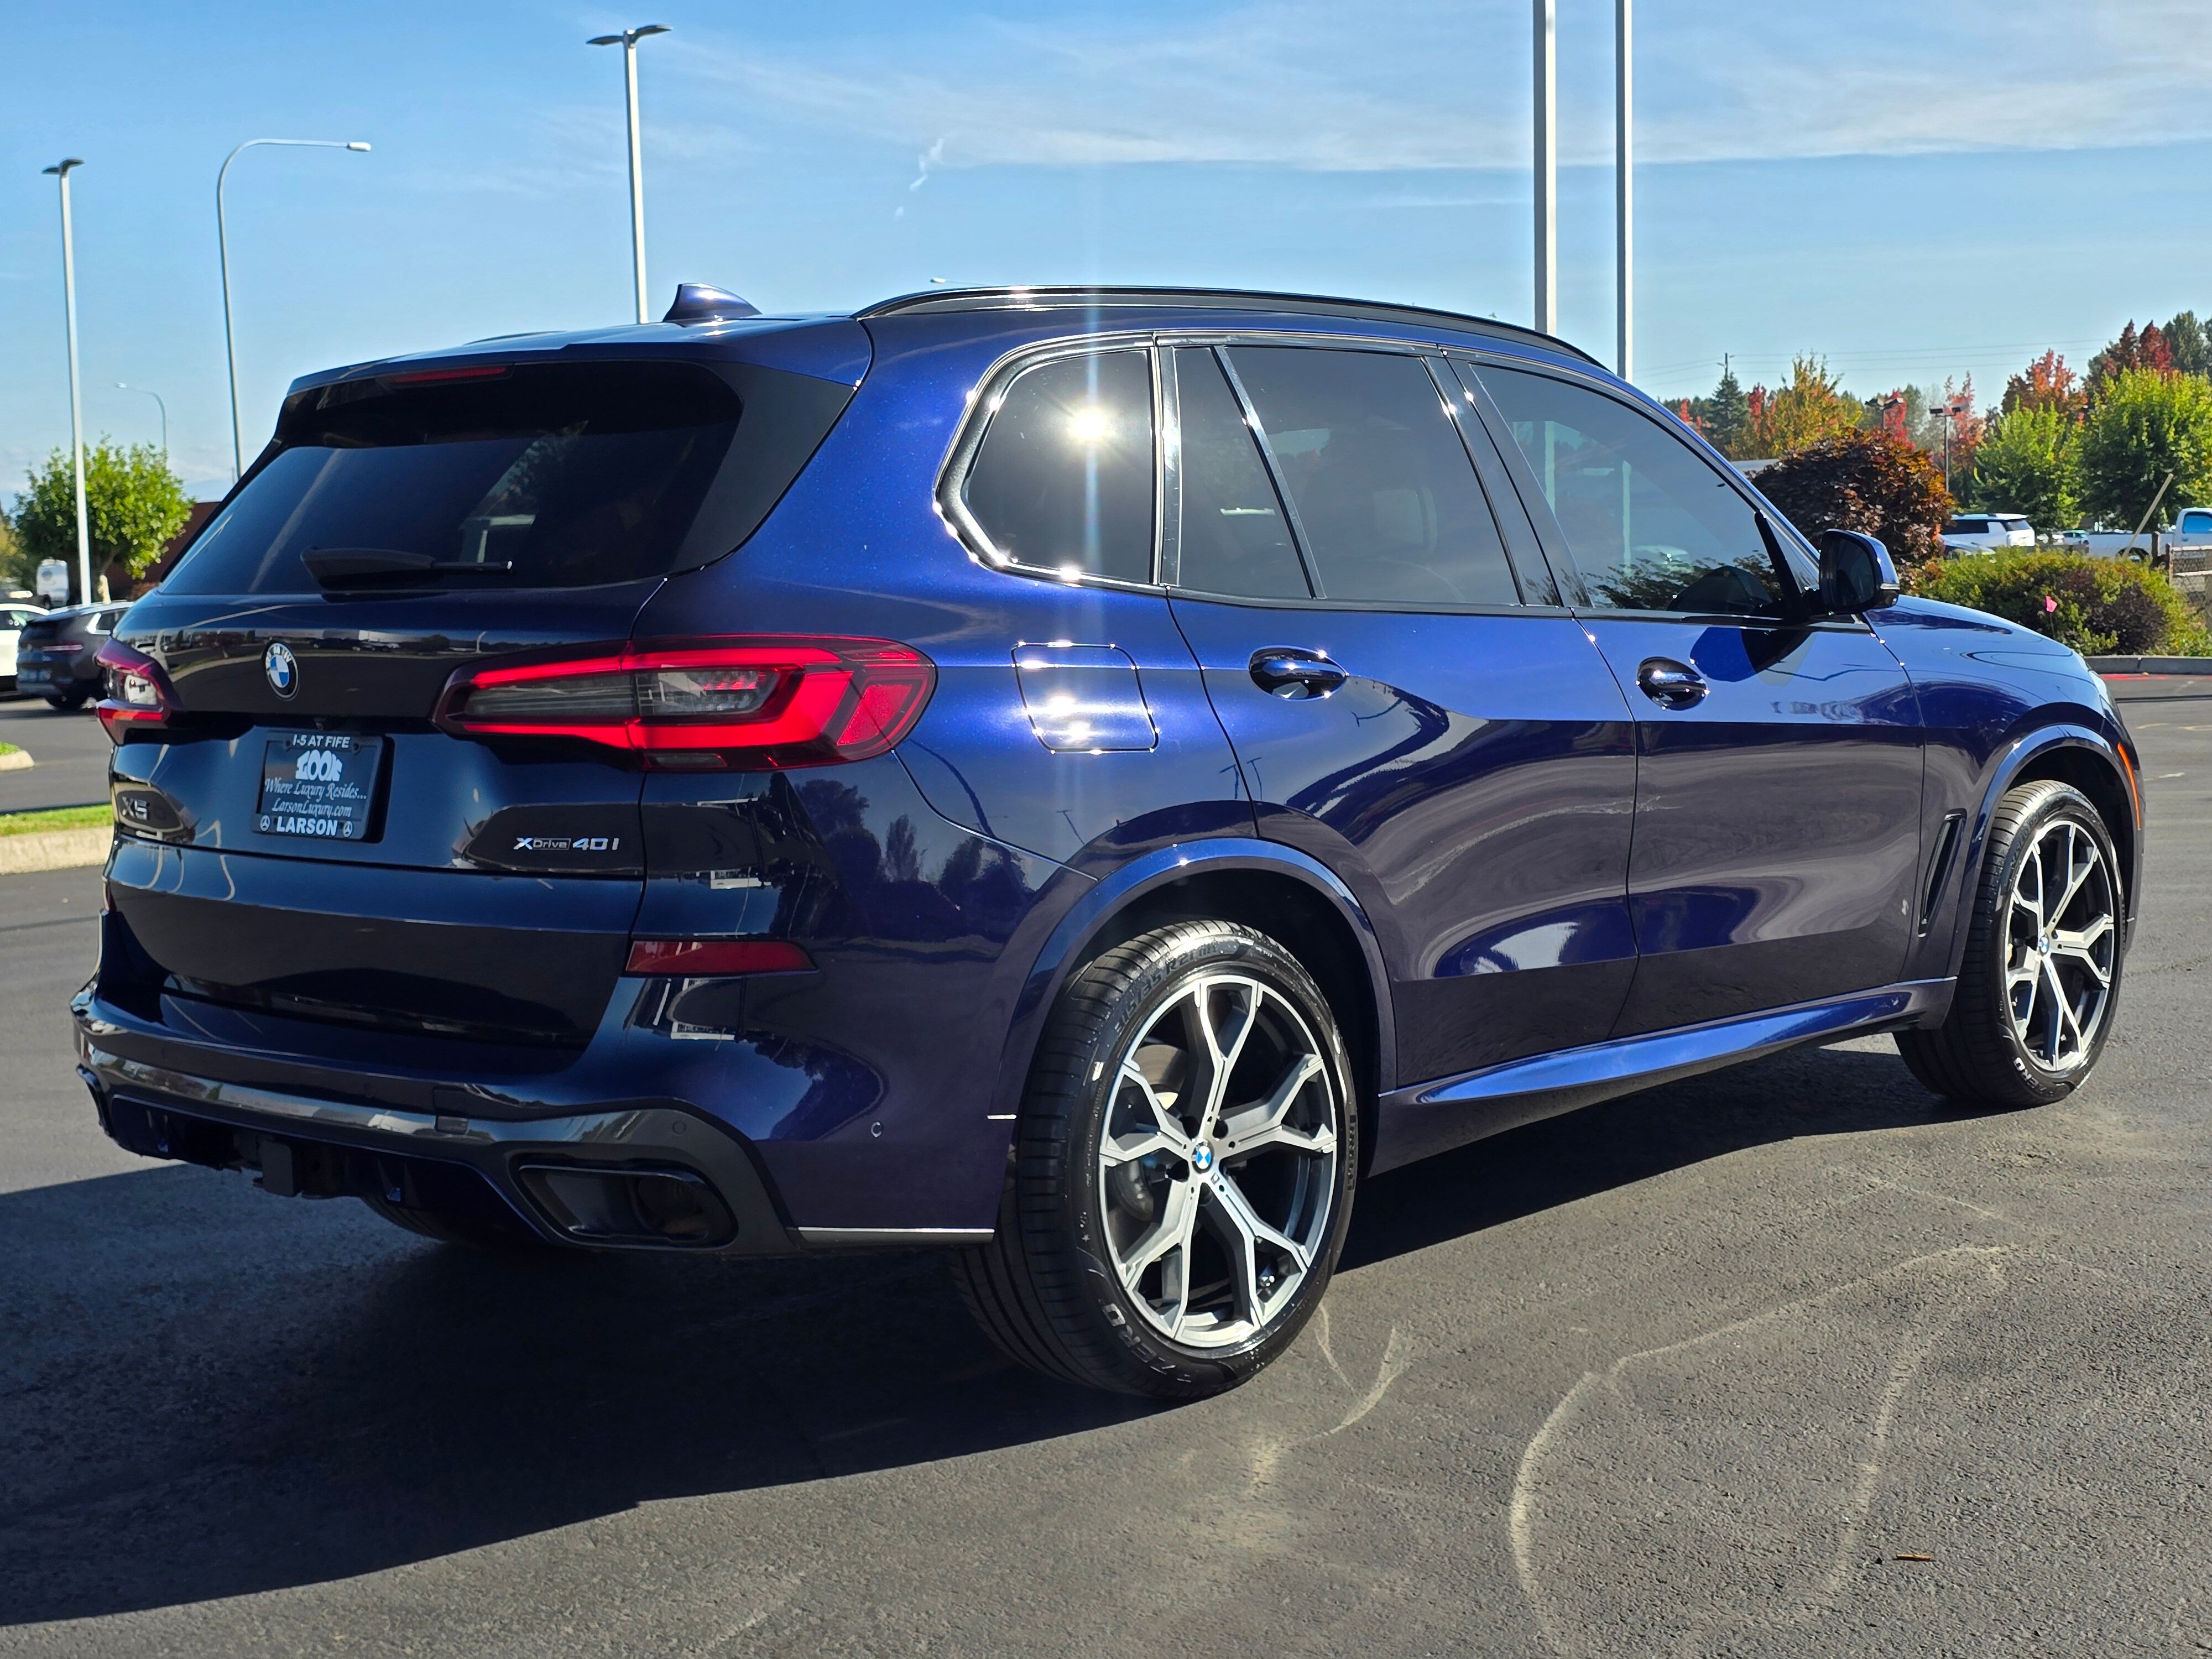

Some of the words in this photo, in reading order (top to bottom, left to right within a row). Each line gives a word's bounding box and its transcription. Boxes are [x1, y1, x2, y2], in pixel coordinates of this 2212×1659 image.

[293, 734, 307, 747] I-5
[307, 735, 324, 747] AT
[325, 736, 351, 748] FIFE
[264, 777, 293, 794] Where
[294, 781, 326, 802] Luxury
[272, 797, 352, 818] LarsonLuxury.com
[276, 816, 338, 836] LARSON
